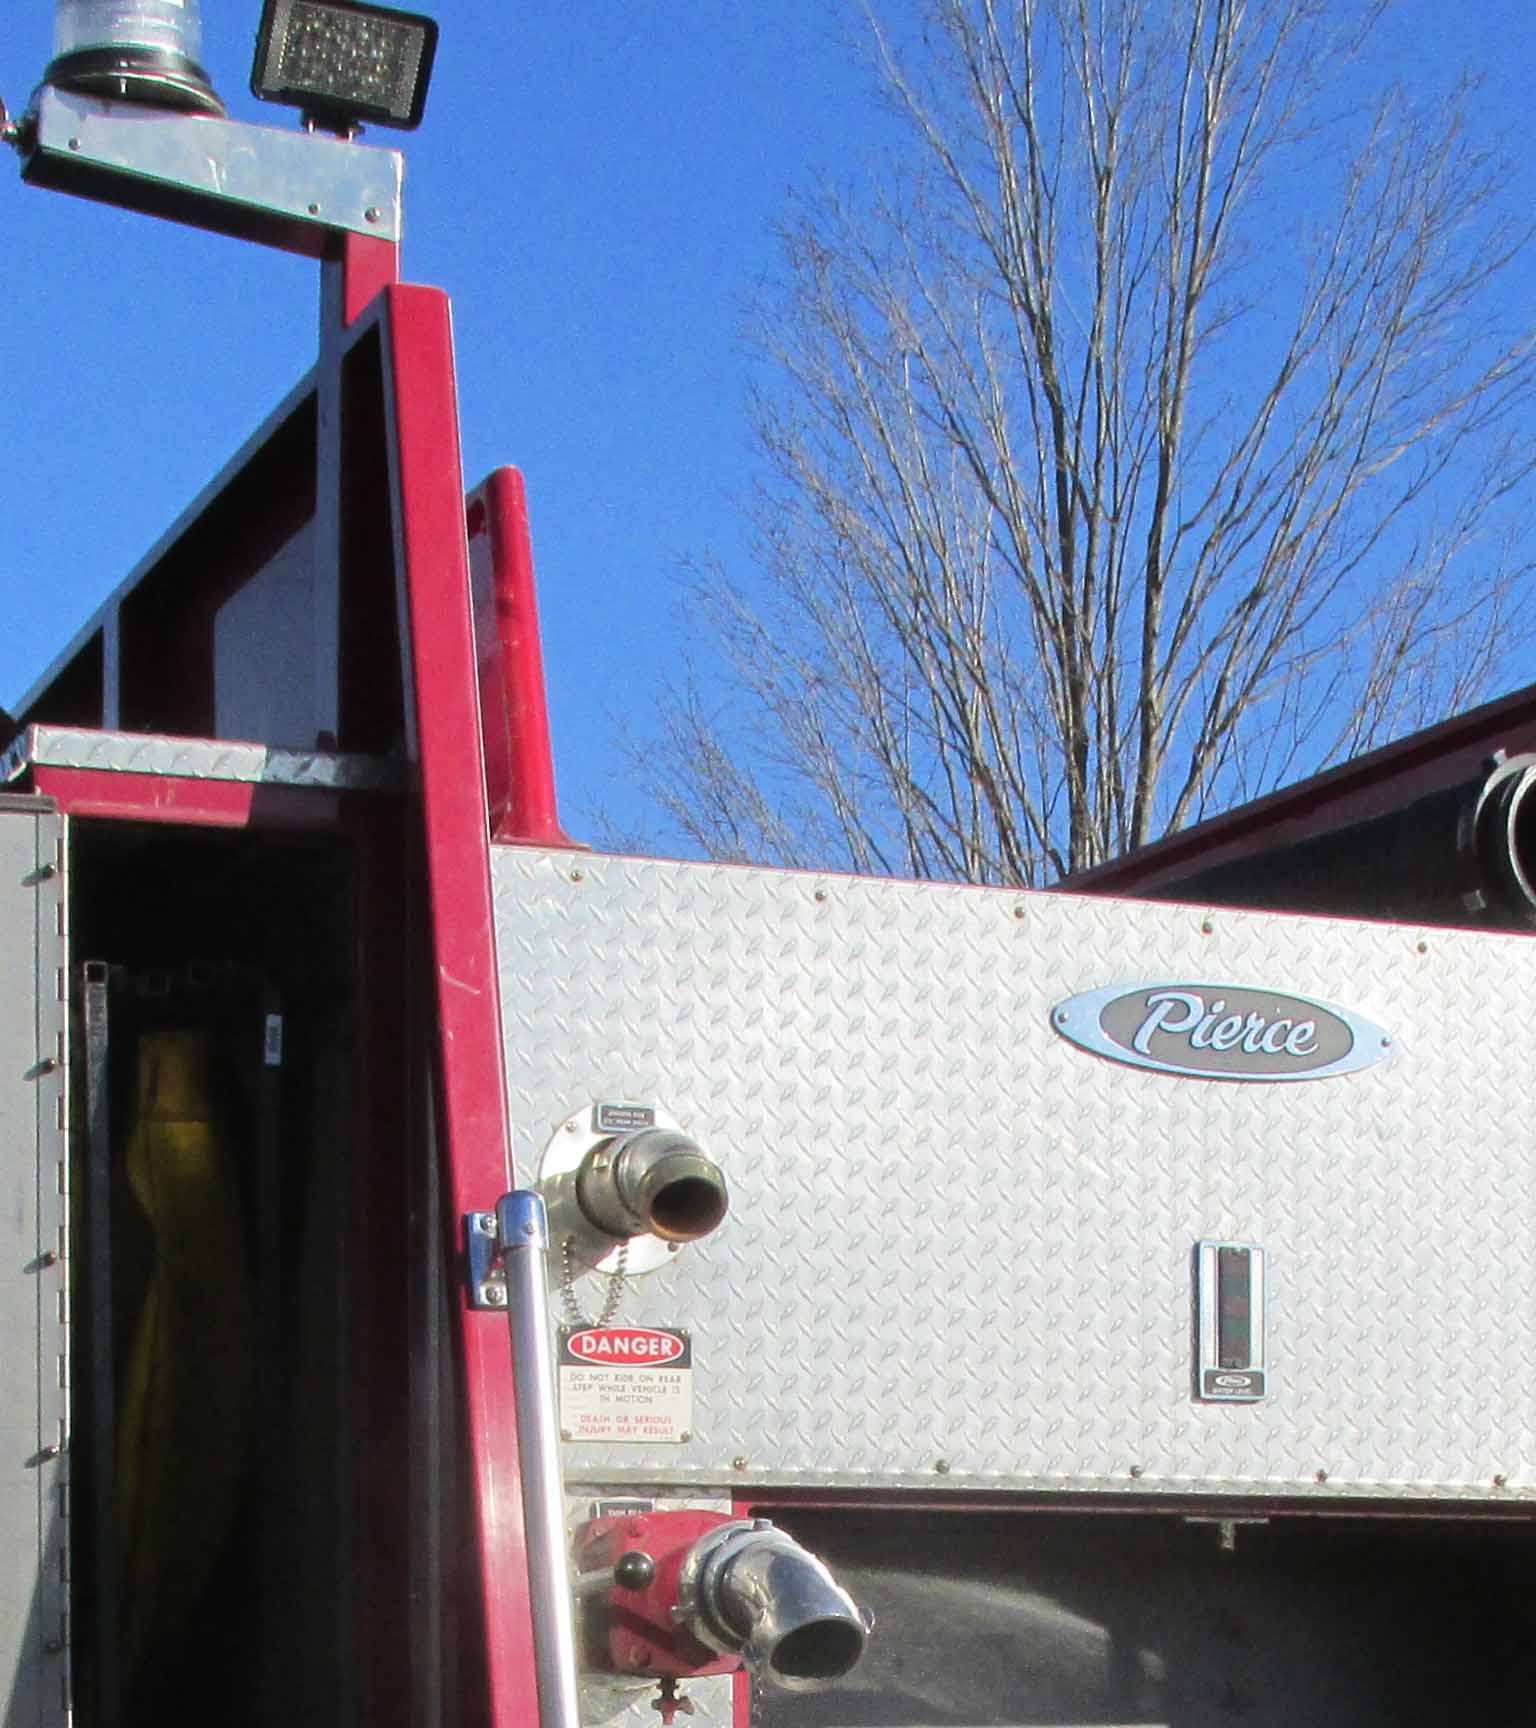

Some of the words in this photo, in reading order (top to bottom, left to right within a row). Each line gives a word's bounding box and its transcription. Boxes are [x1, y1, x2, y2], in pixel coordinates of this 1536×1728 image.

[1132, 992, 1319, 1057] Pierce
[581, 1336, 673, 1356] DANGER
[590, 1374, 609, 1382] NOT
[615, 1395, 653, 1404] MOTION
[580, 1415, 610, 1423] DEATH
[634, 1416, 672, 1425] SERIOUS
